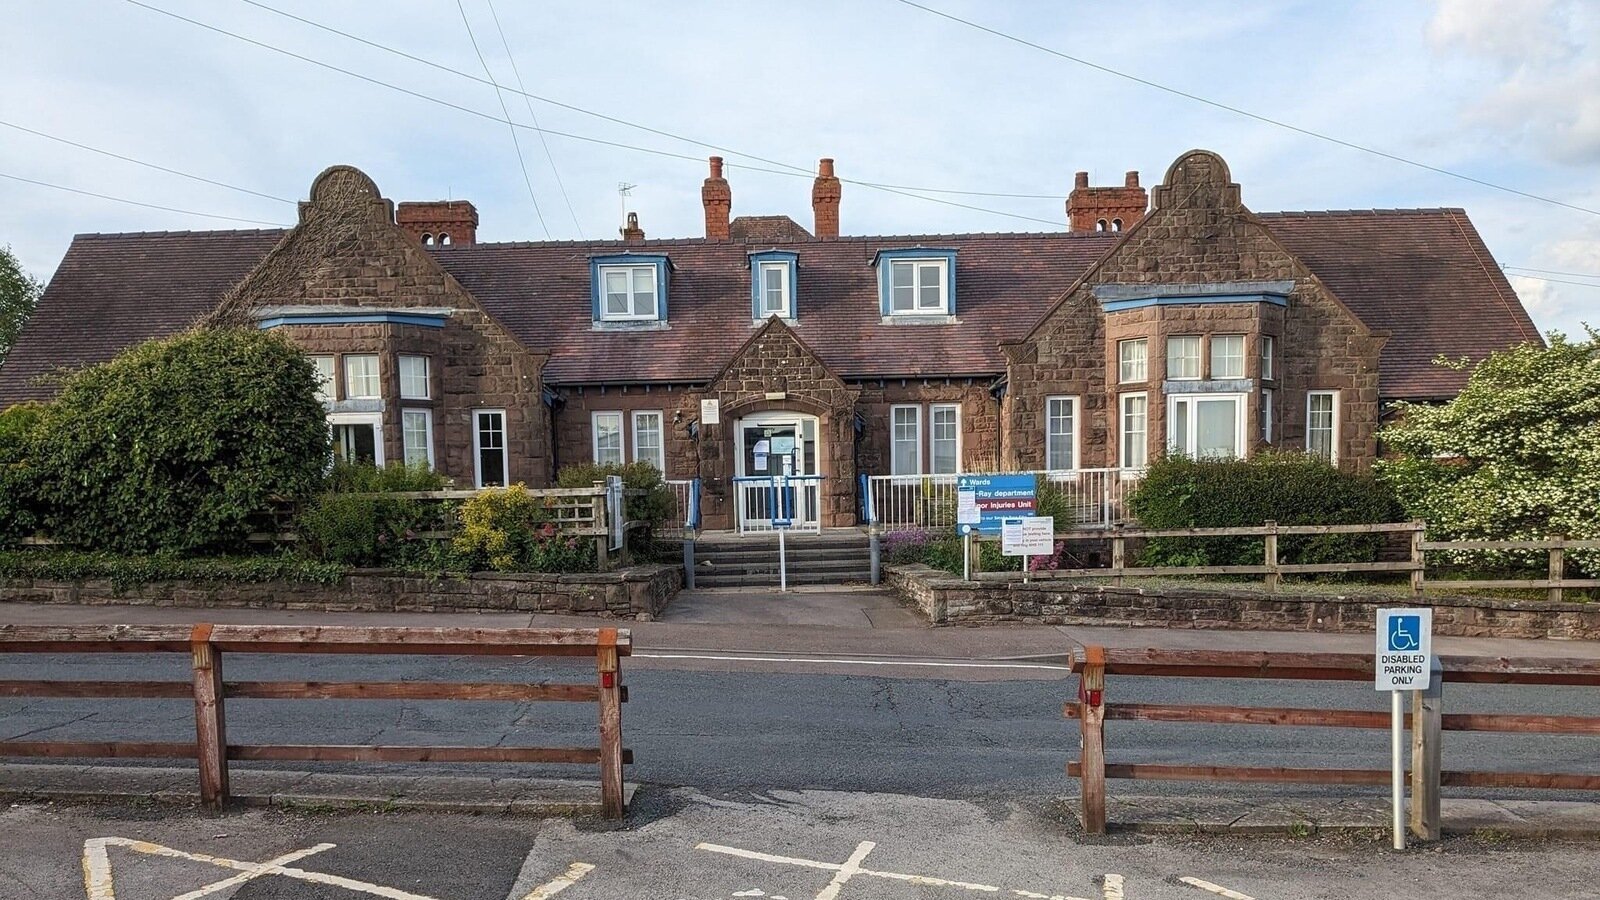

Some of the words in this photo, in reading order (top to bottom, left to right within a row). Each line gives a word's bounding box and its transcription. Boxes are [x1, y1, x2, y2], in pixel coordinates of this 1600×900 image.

[994, 490, 1034, 498] department
[990, 501, 1016, 509] Injuries
[1381, 655, 1425, 664] DISABLED
[1384, 665, 1422, 674] PARKING
[1391, 676, 1414, 685] ONLY
